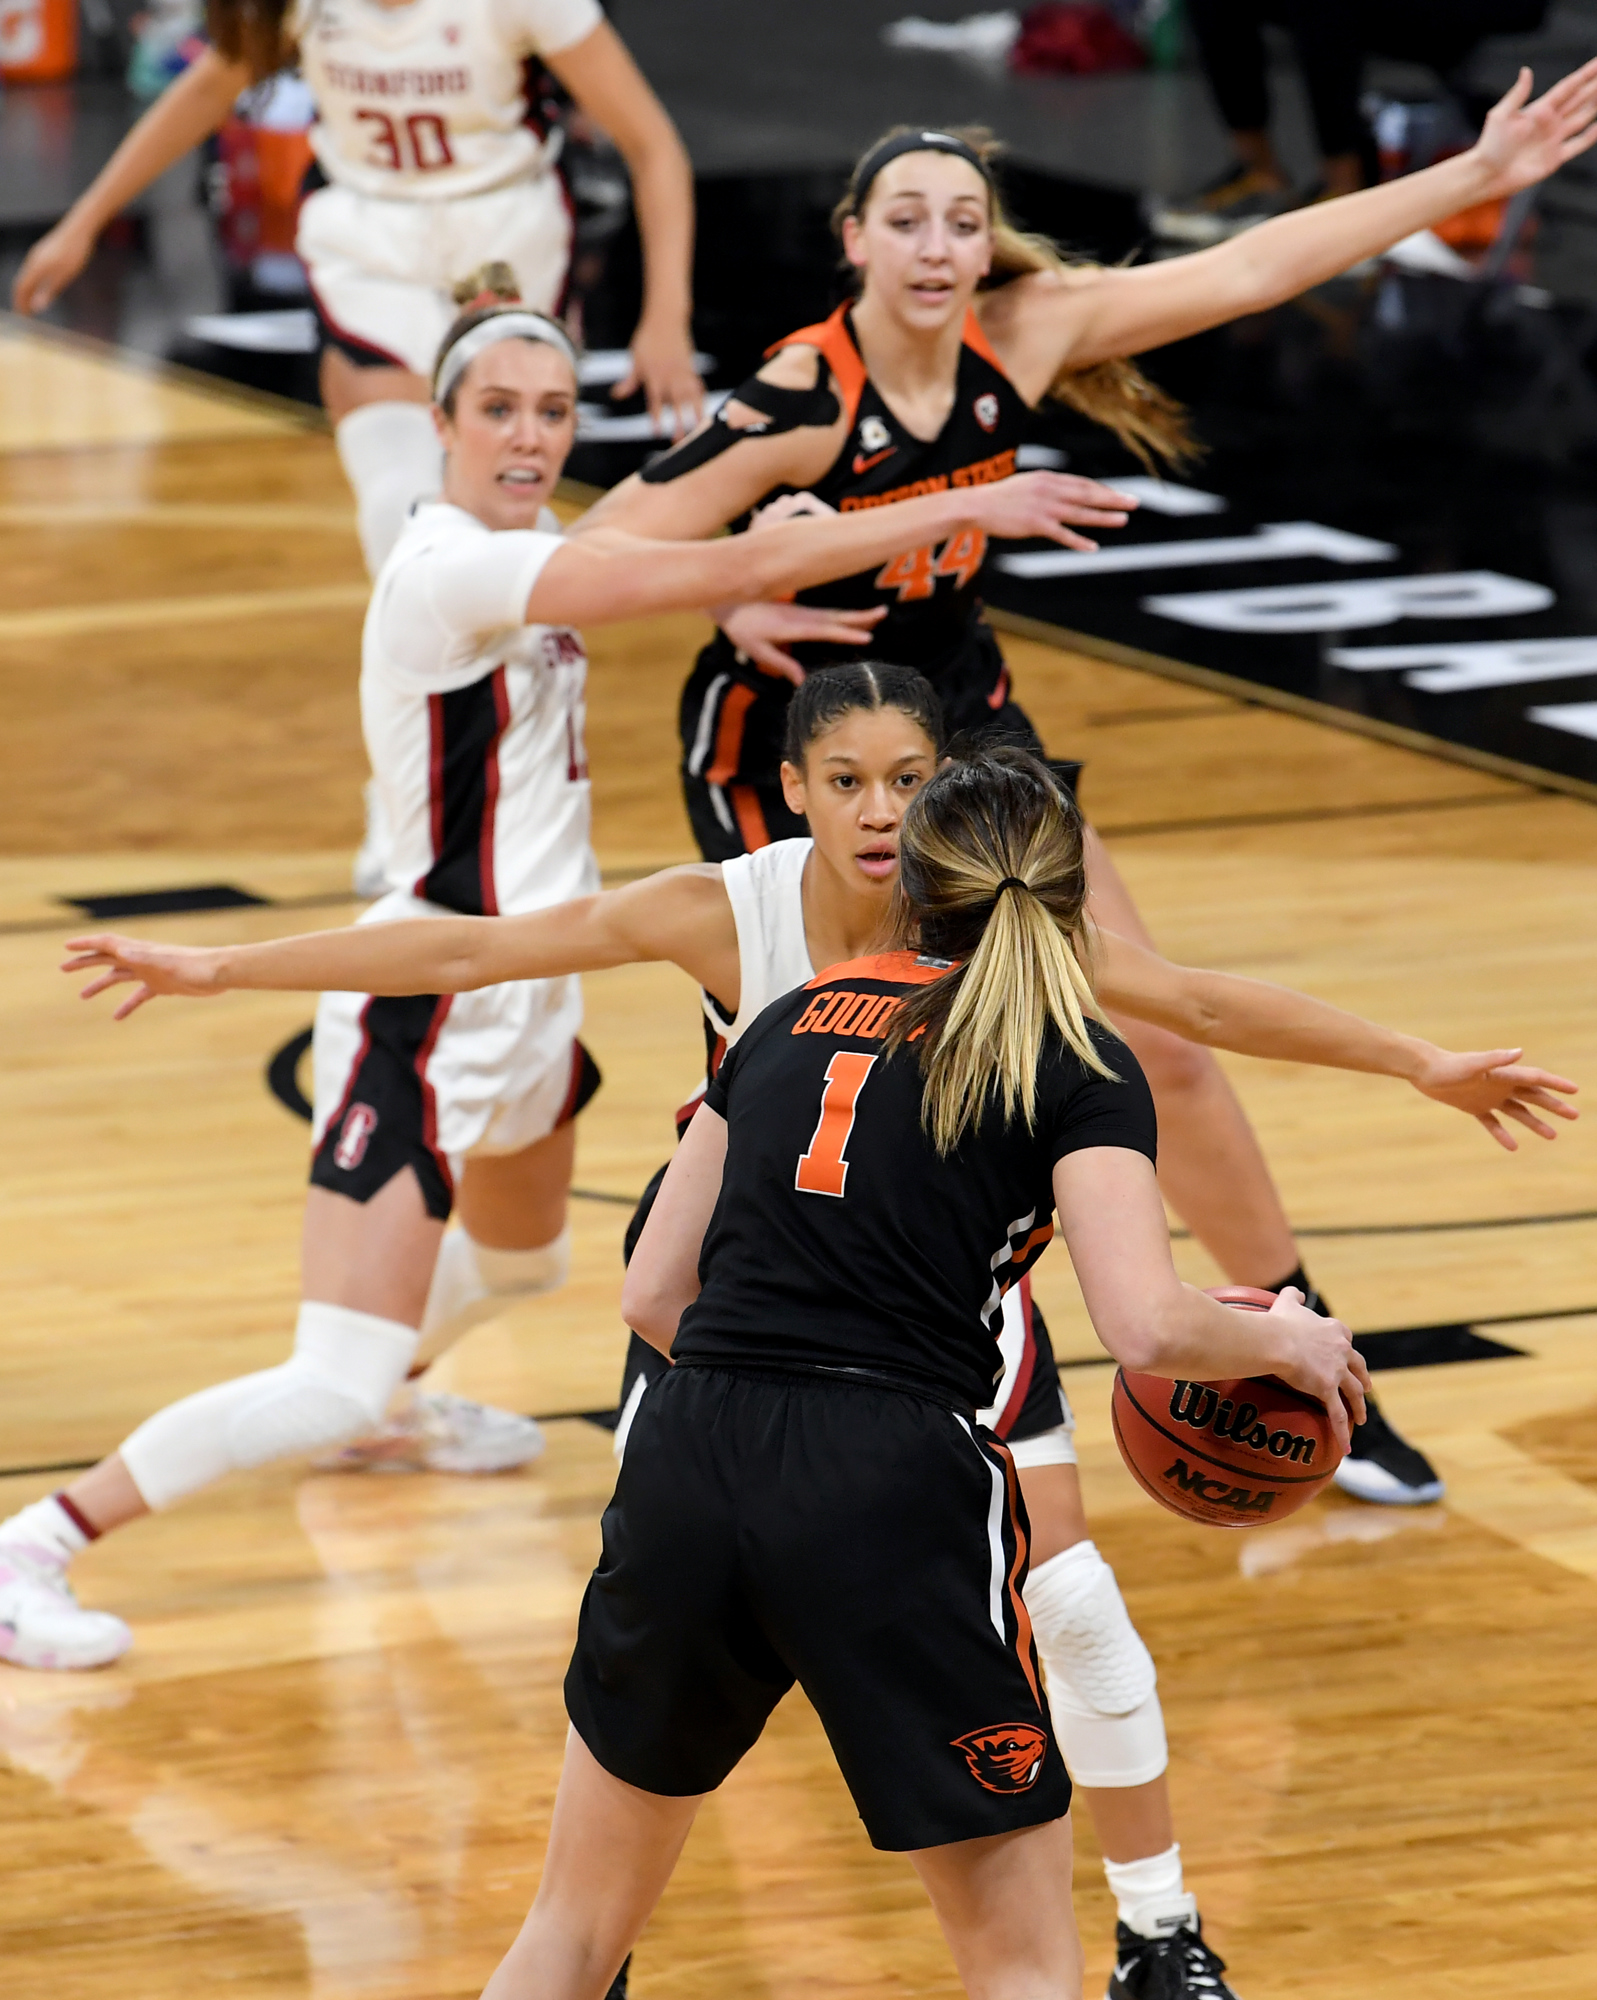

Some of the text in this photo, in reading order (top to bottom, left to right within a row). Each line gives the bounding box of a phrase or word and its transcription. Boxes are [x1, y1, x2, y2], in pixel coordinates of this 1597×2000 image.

[354, 107, 455, 173] 30
[873, 527, 988, 603] 44
[791, 991, 929, 1042] GOOD
[795, 1051, 879, 1198] 1
[1169, 1379, 1316, 1466] Wilson
[1163, 1458, 1276, 1513] NCAA
